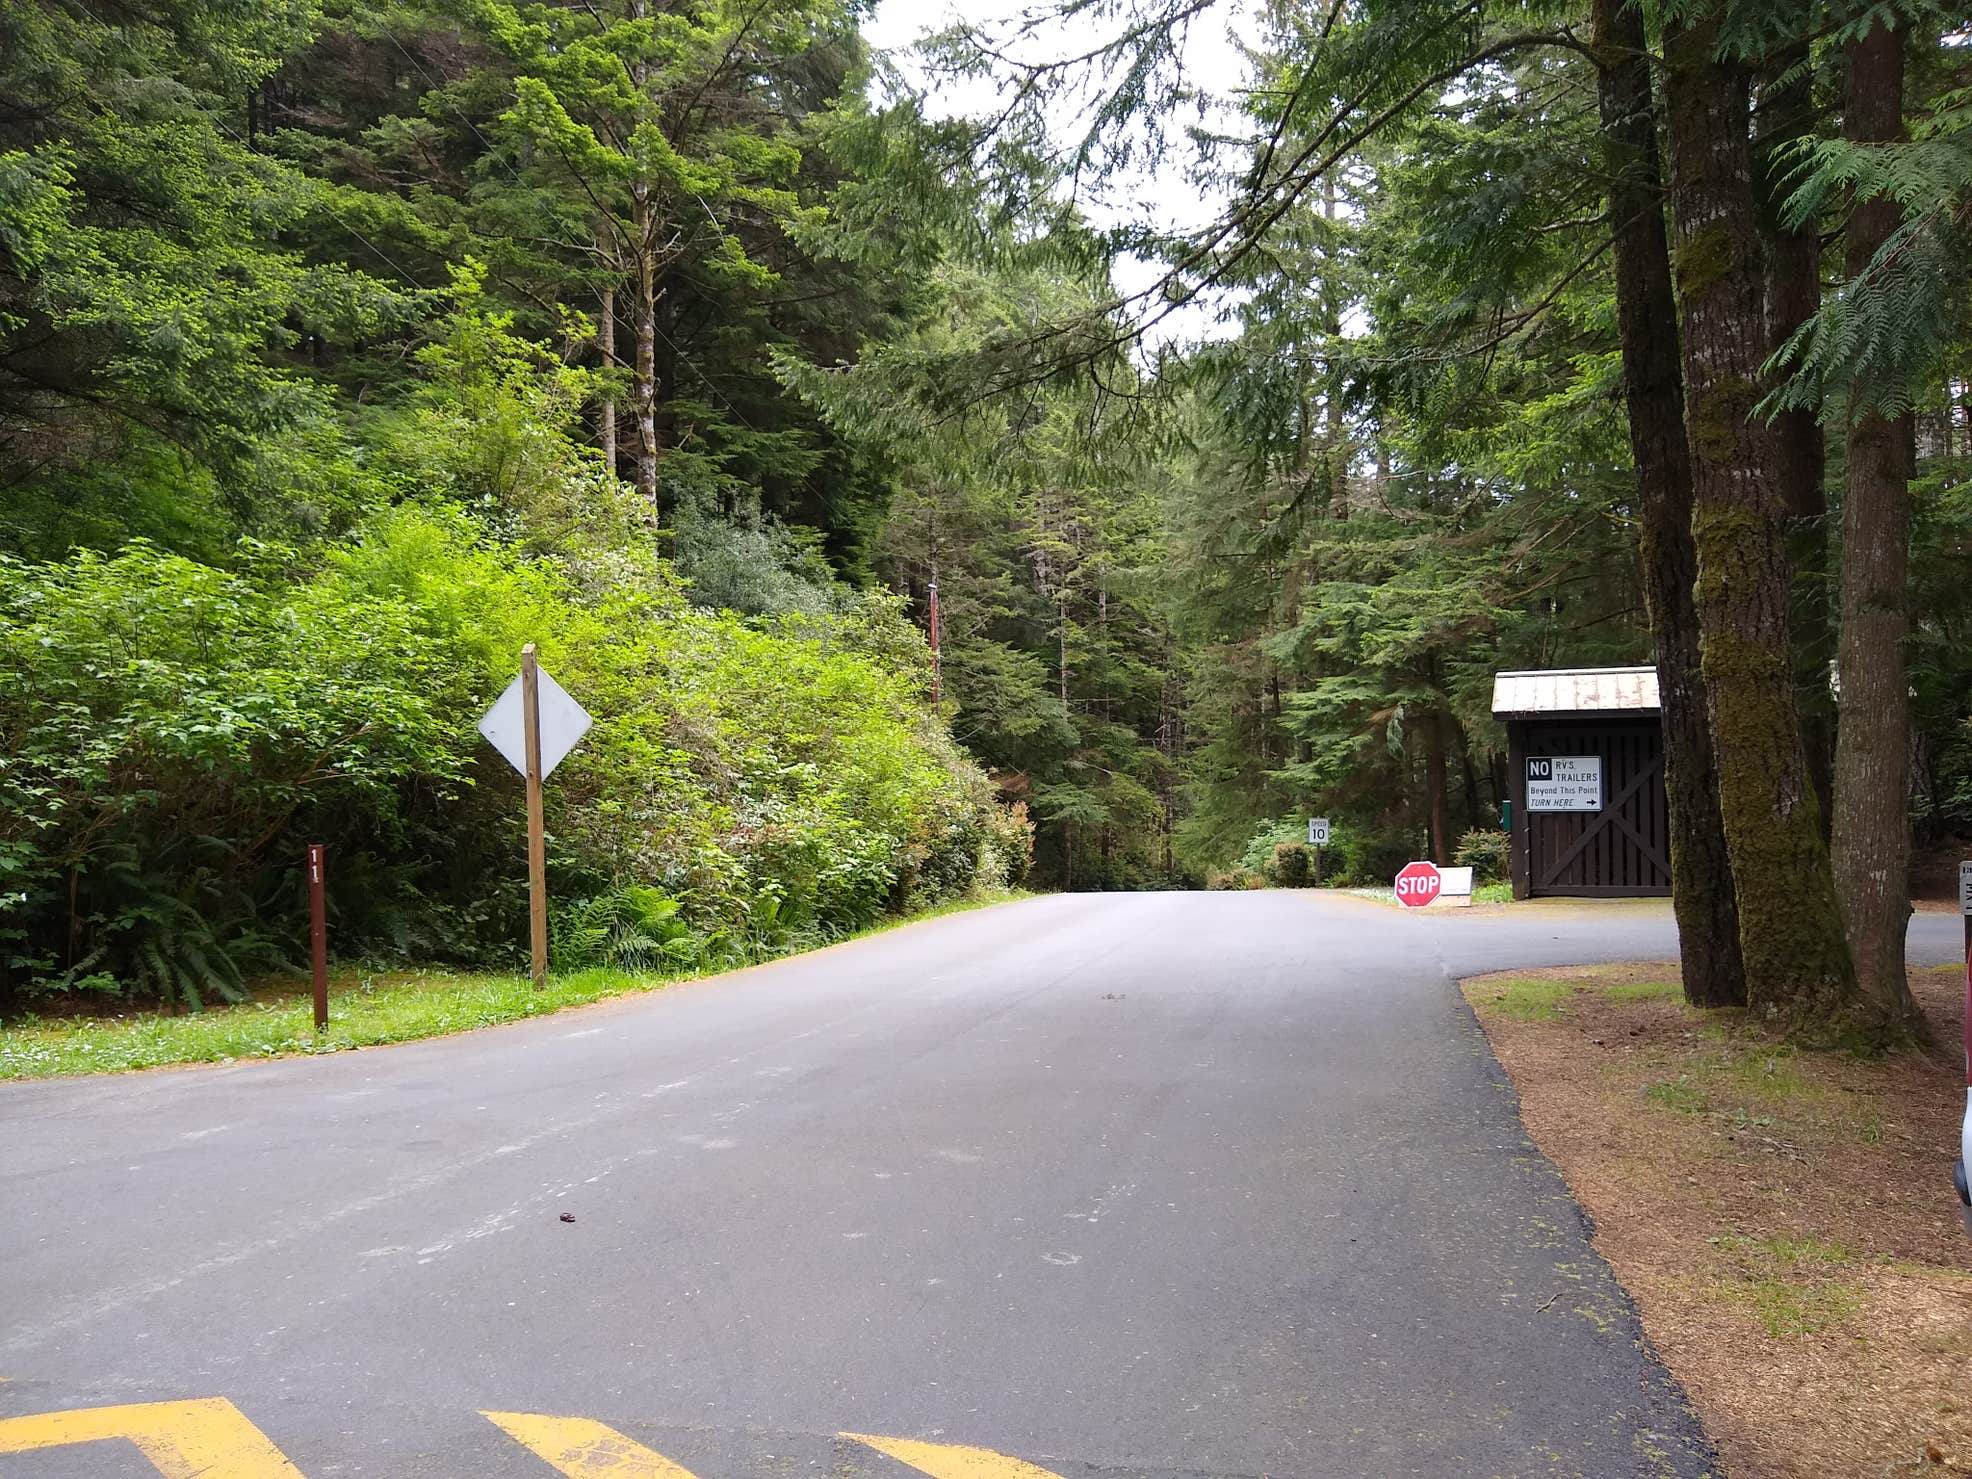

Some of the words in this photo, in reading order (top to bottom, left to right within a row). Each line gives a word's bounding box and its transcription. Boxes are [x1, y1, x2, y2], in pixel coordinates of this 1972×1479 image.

[1529, 761, 1549, 776] NO
[1556, 773, 1598, 782] TRAILERS
[1530, 787, 1558, 796] Beyond
[1561, 786, 1576, 794] This
[1578, 786, 1598, 794] Point
[1531, 799, 1551, 807] TURN
[1553, 798, 1575, 807] HERE
[1312, 828, 1325, 839] 10
[1398, 875, 1439, 895] STOP
